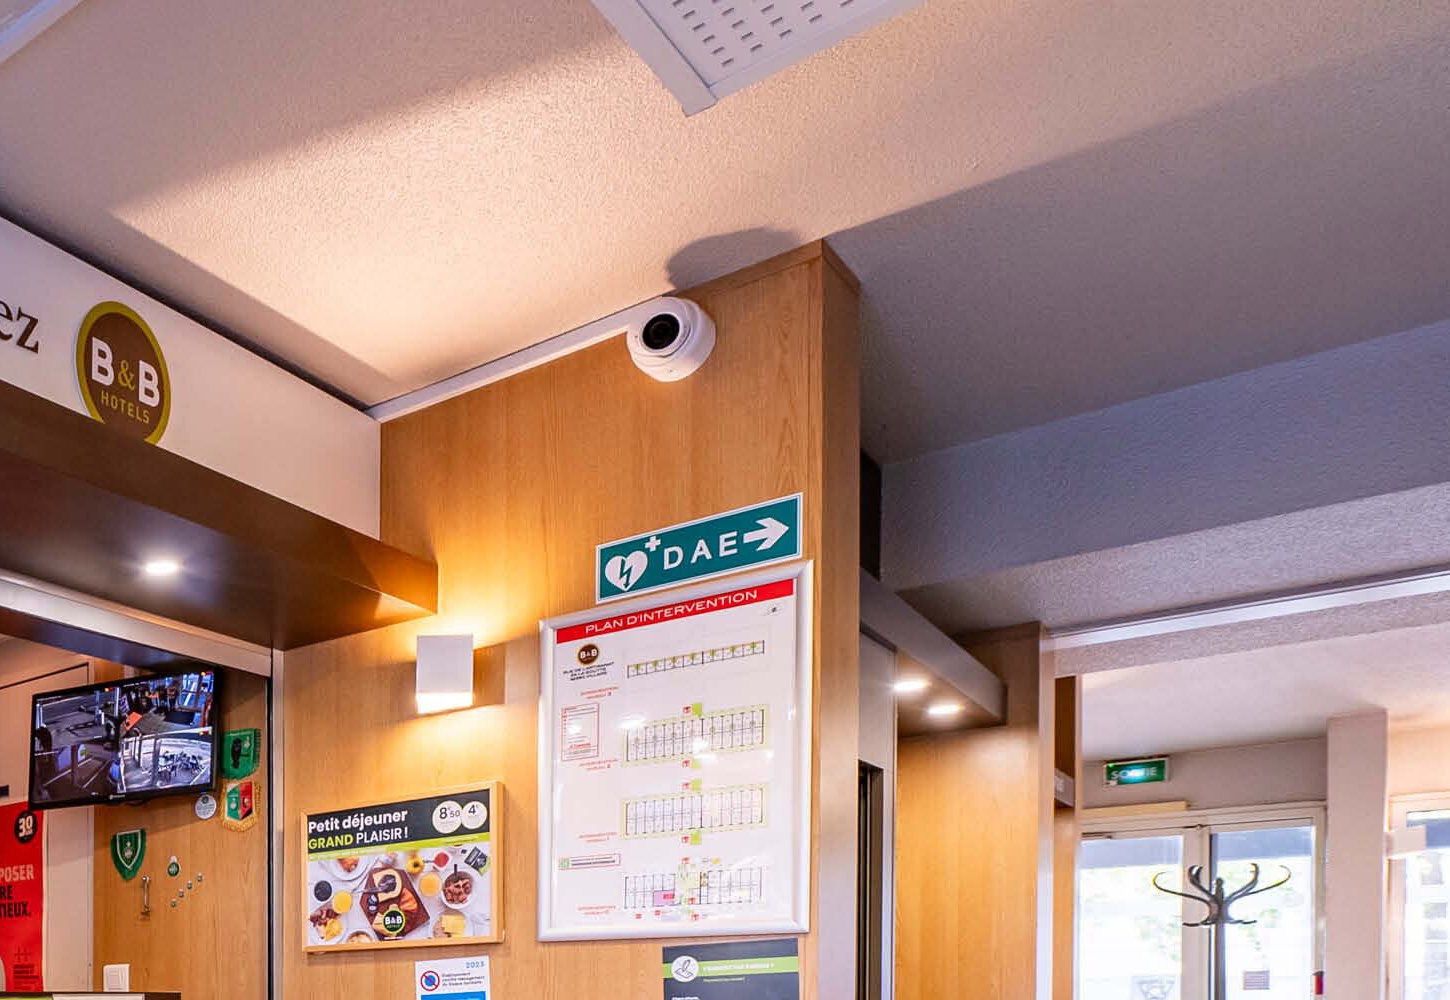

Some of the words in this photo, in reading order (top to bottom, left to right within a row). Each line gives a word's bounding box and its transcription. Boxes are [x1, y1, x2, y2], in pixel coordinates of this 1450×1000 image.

[91, 337, 160, 407] B&B
[101, 388, 150, 424] HOTELS
[662, 530, 739, 571] DAE
[585, 617, 623, 635] PLAN
[627, 589, 759, 626] D'INTERVENTION
[580, 648, 598, 660] B&B
[308, 817, 340, 834] Petit
[342, 810, 409, 830] déjeuner
[308, 834, 354, 850] GRAND
[356, 828, 402, 845] PLAISIR
